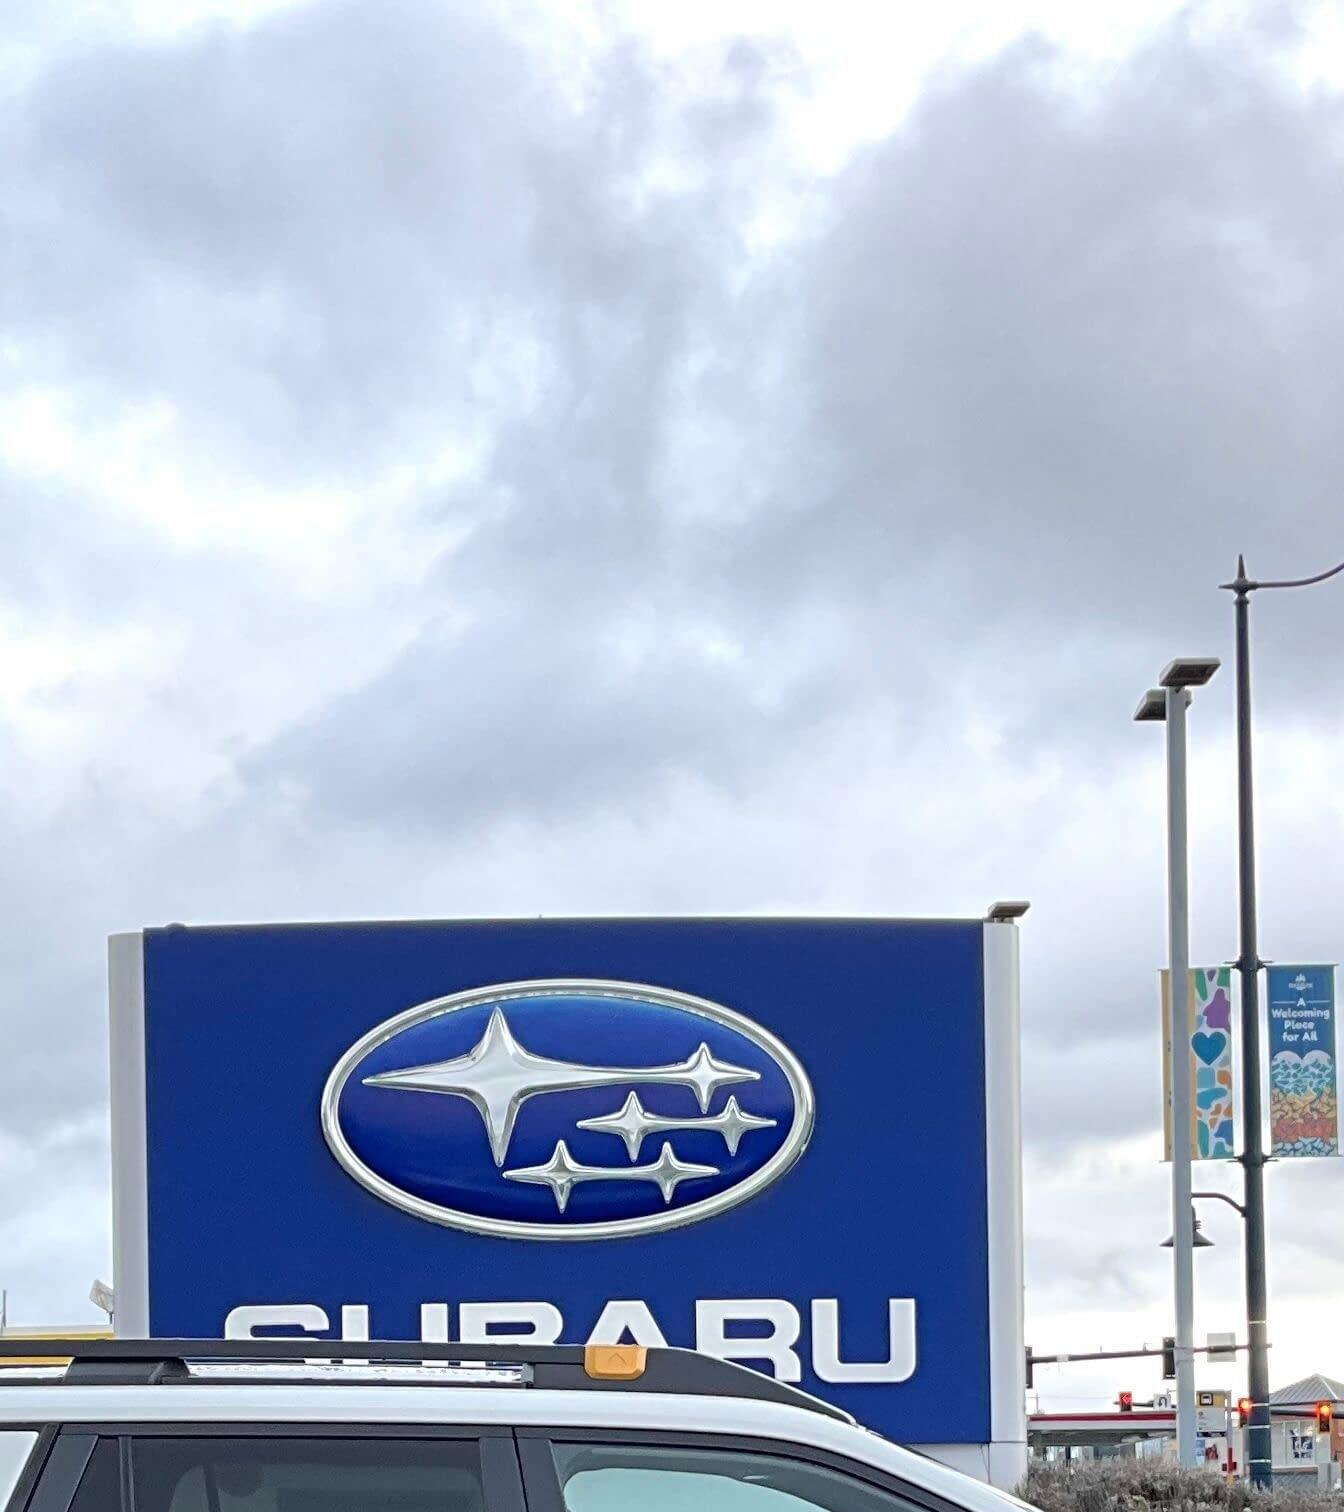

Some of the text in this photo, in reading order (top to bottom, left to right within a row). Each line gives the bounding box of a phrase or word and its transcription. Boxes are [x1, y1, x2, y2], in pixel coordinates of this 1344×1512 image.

[1296, 997, 1306, 1007] A
[1271, 1008, 1330, 1020] Welcoming
[1284, 1020, 1315, 1030] Place
[1282, 1031, 1318, 1042] for All
